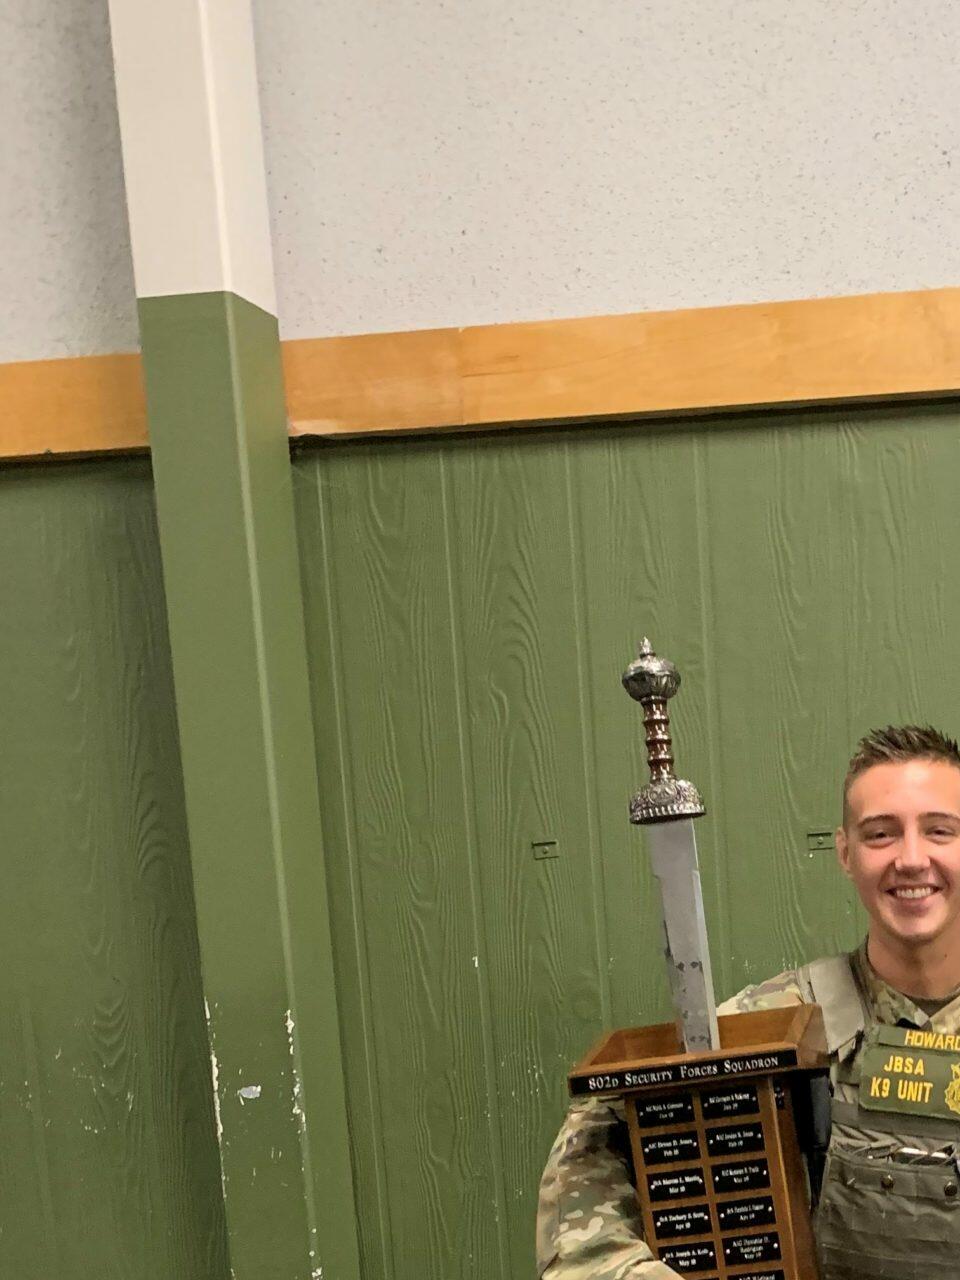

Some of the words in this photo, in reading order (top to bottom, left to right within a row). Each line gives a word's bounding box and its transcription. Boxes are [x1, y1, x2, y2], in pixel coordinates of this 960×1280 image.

[884, 1056, 924, 1076] JBSA
[870, 1077, 890, 1098] K9
[898, 1080, 933, 1103] UNIT
